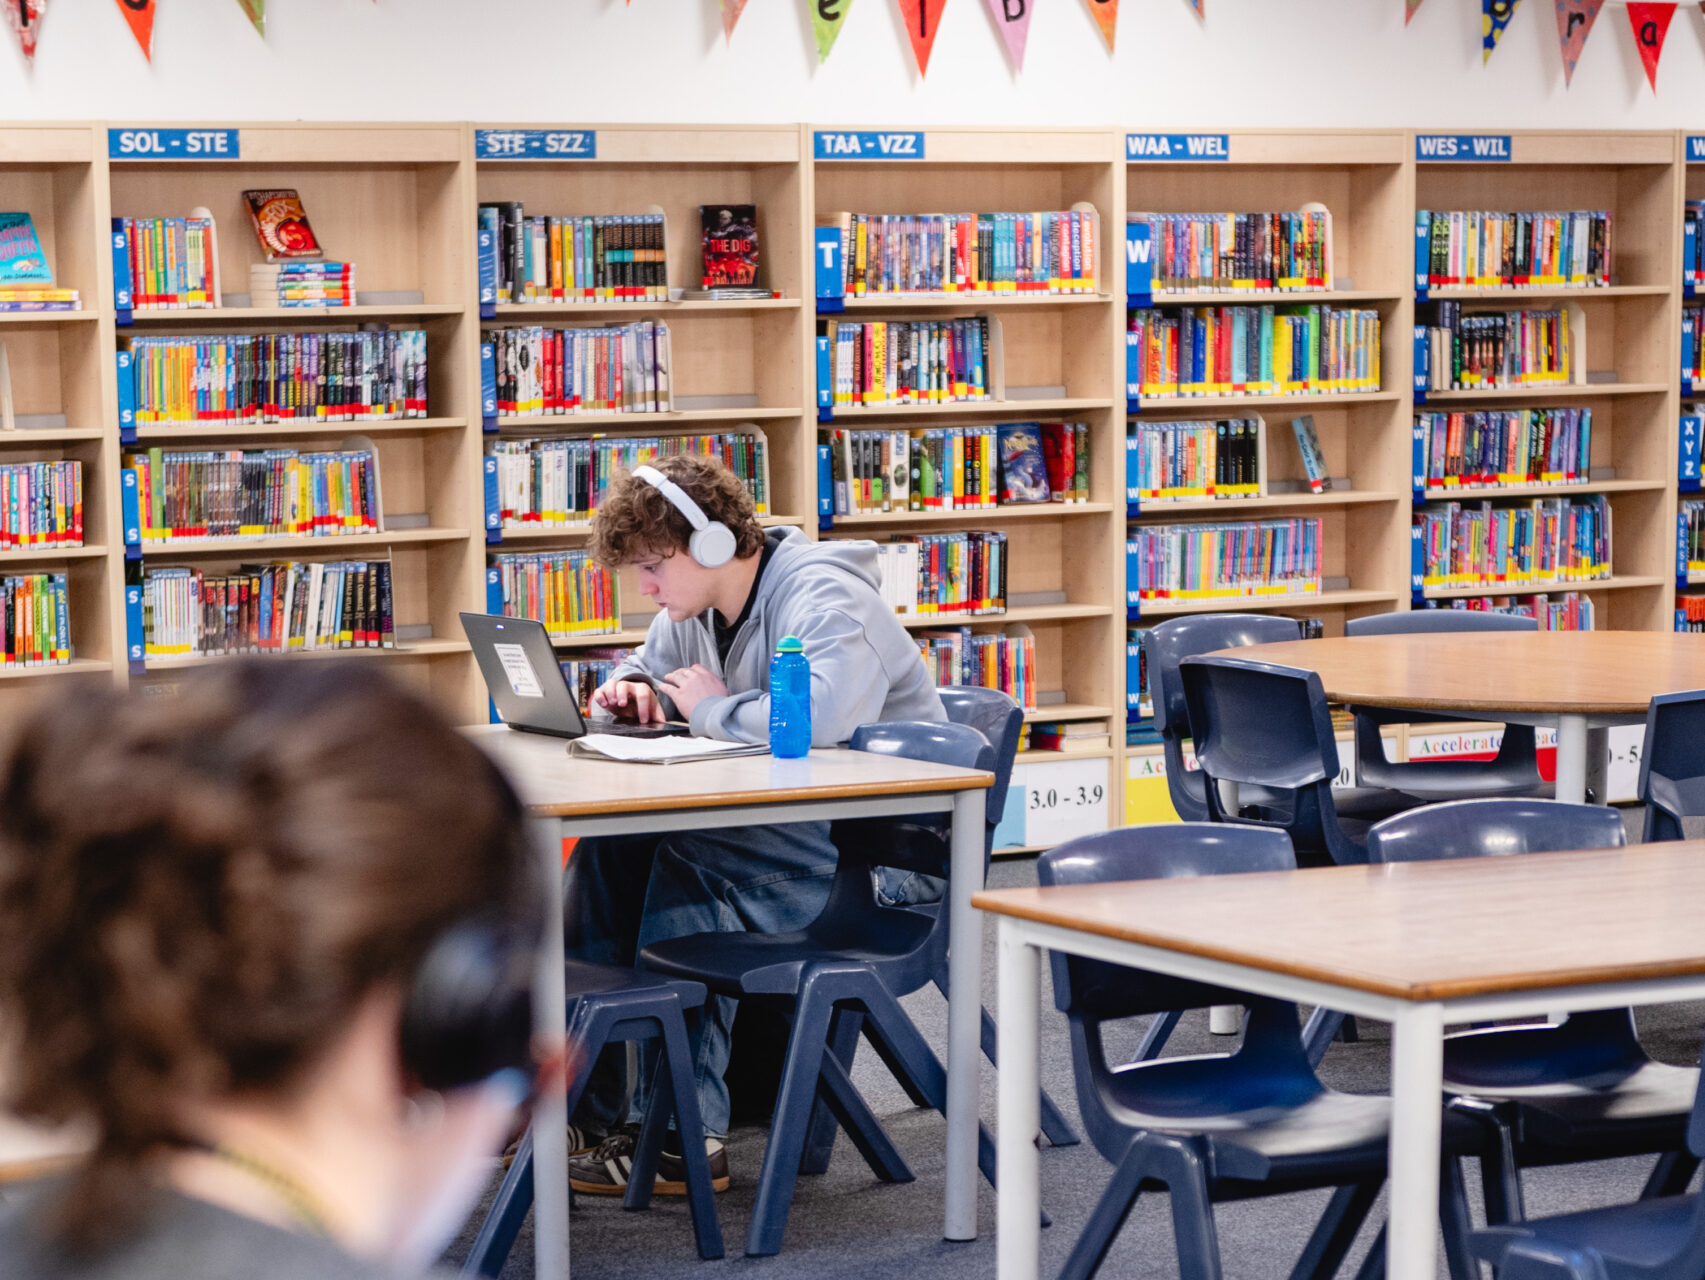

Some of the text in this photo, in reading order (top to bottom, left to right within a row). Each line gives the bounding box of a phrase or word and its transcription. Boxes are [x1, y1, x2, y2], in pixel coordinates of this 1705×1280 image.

[1640, 21, 1657, 46] a
[119, 132, 165, 153] SOL
[187, 132, 228, 153] STE
[486, 133, 525, 154] STE
[545, 133, 585, 153] SZZ
[822, 135, 861, 154] TAA
[878, 135, 916, 154] VZZ
[1128, 137, 1171, 155] WAA
[1186, 137, 1226, 156] WEL
[1420, 138, 1457, 156] WES
[1473, 138, 1507, 156] WIL
[1417, 227, 1428, 238] W
[1685, 224, 1695, 235] W
[115, 235, 125, 248] S
[480, 234, 490, 247] S
[710, 239, 751, 253] THE DIG
[1062, 222, 1071, 272] contagion
[1072, 221, 1081, 271] deception
[1083, 220, 1093, 271] evolution
[818, 242, 838, 268] T
[1127, 240, 1150, 263] W
[1417, 274, 1428, 285] W
[1685, 270, 1695, 281] W
[118, 291, 128, 304] S
[1415, 328, 1426, 339] W
[1683, 323, 1693, 334] W
[819, 339, 828, 350] T
[1127, 334, 1139, 345] W
[483, 346, 492, 359] S
[119, 354, 129, 367] S
[1683, 368, 1693, 380] W
[1416, 376, 1426, 387] W
[821, 390, 829, 401] T
[1127, 383, 1139, 395] W
[485, 399, 494, 412] S
[122, 410, 131, 423] S
[1414, 429, 1425, 440] W
[1127, 438, 1138, 450] W
[820, 448, 829, 459] T
[486, 461, 496, 474] S
[125, 474, 135, 487] S
[1415, 475, 1425, 486] W
[1127, 487, 1139, 498] W
[822, 499, 830, 510] T
[489, 513, 498, 526] S
[128, 528, 138, 541] S
[1412, 528, 1423, 539] W
[1127, 542, 1138, 553] W
[1678, 517, 1686, 572] VERSE
[489, 571, 498, 584] S
[1413, 575, 1424, 586] W
[129, 591, 138, 604] S
[1127, 591, 1139, 603] W
[132, 645, 141, 658] S
[1127, 645, 1139, 656] W
[1127, 693, 1139, 704] W
[1030, 788, 1058, 810] 3.0
[1076, 785, 1103, 806] 3.9
